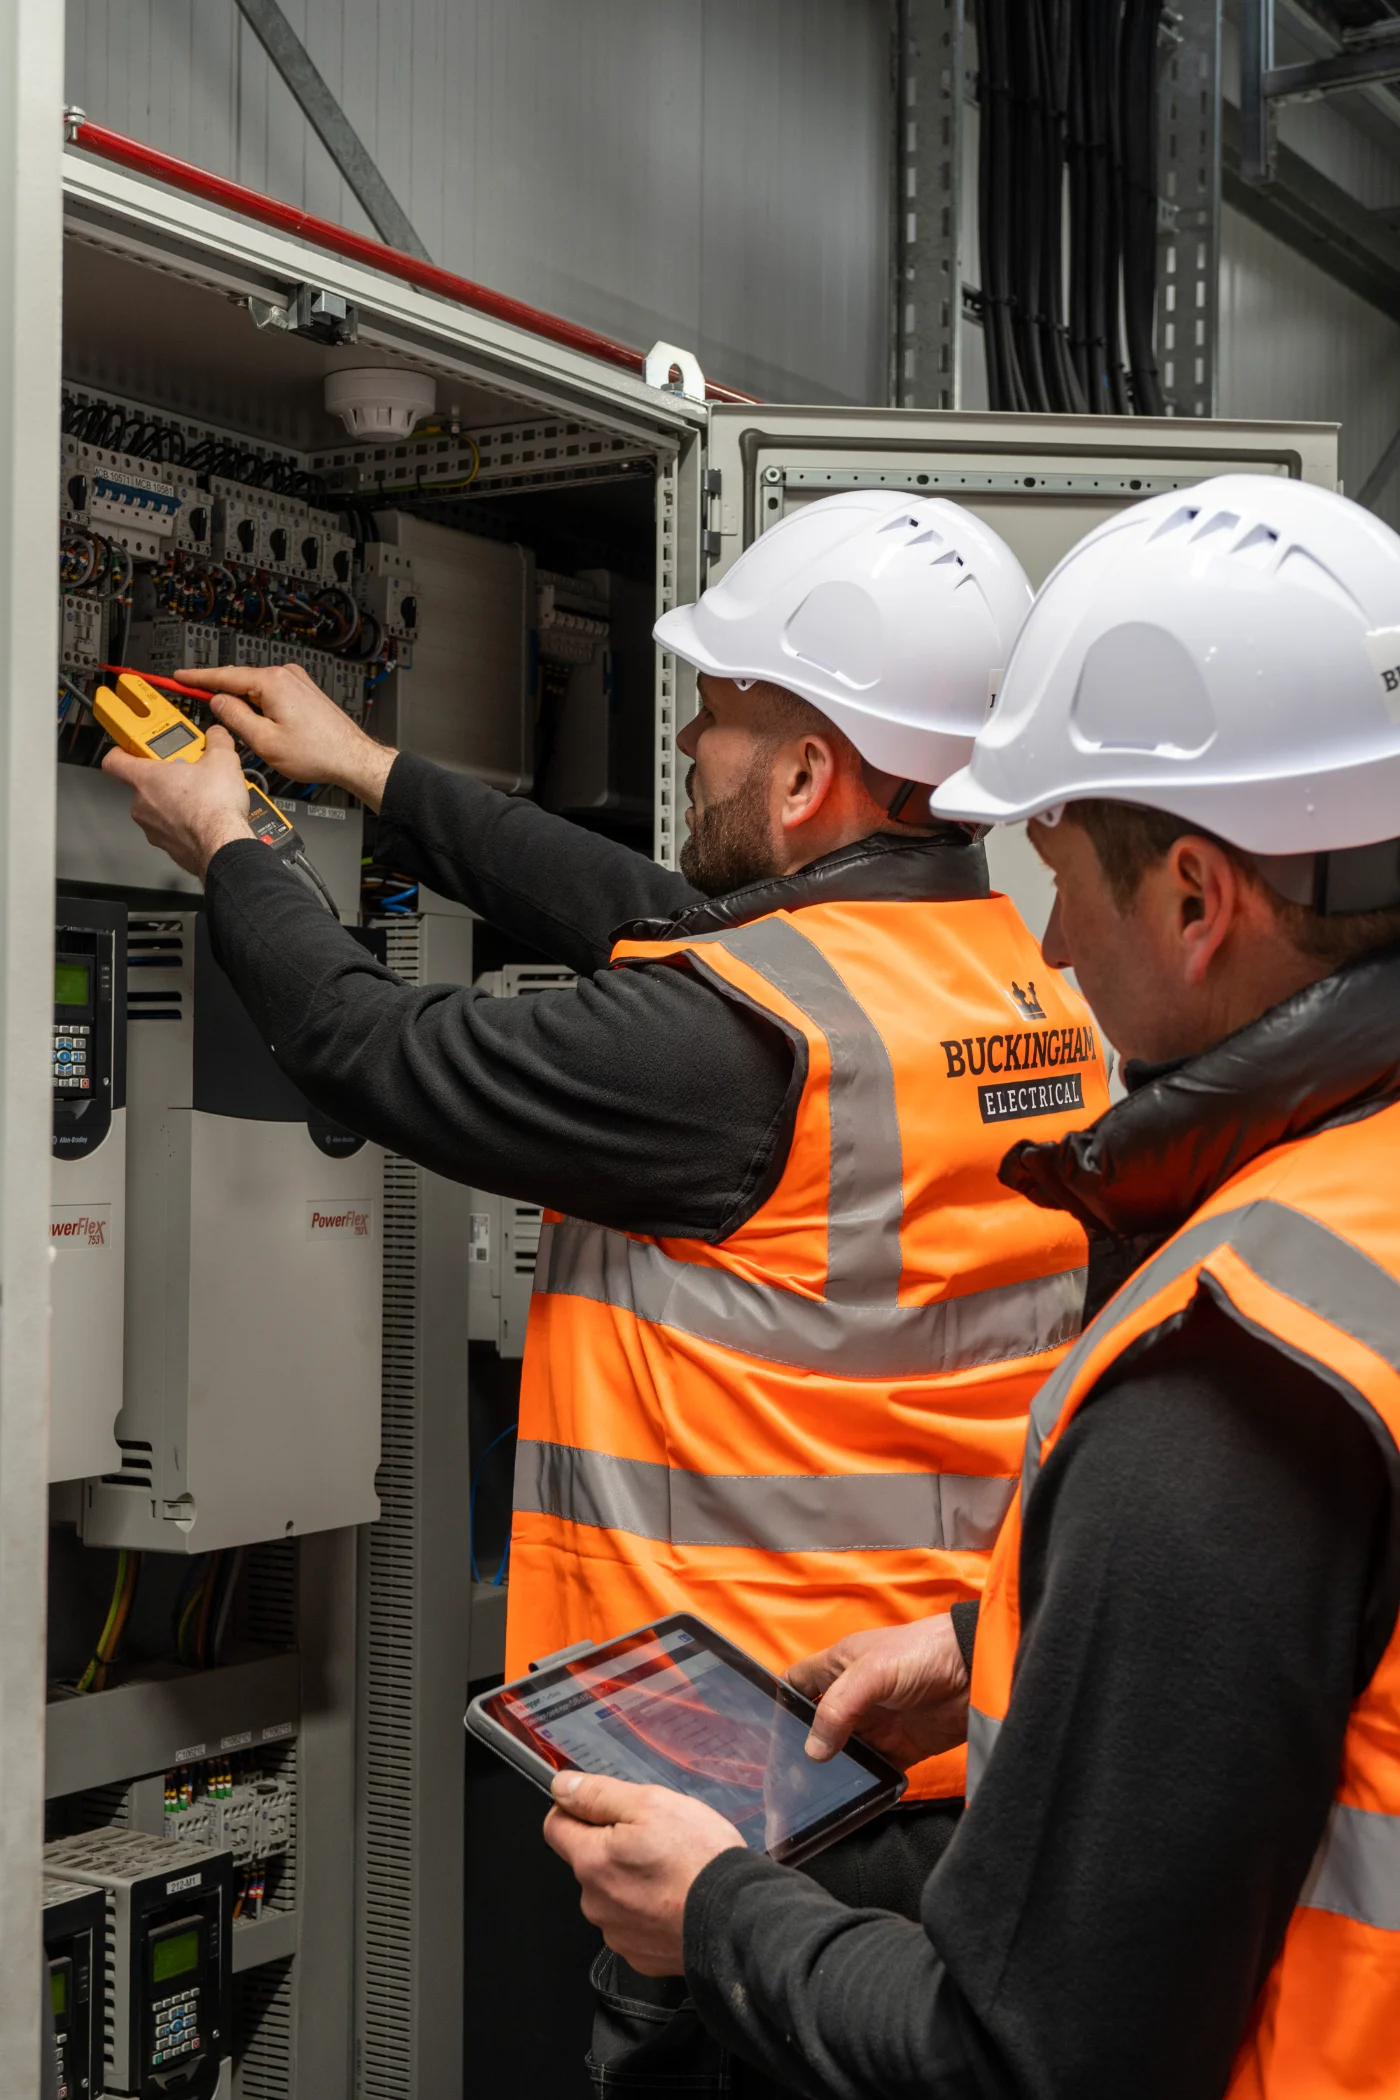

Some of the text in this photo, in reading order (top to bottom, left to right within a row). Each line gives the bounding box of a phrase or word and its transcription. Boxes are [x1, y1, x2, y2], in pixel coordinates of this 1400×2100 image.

[135, 477, 151, 490] MCB
[940, 1026, 1097, 1078] BUCKINGHAM
[984, 1081, 1080, 1116] ELECTRICAL
[50, 1216, 106, 1244] werFlex
[310, 1210, 369, 1236] PowerFlex
[88, 1235, 100, 1245] 753
[171, 1876, 196, 1892] 212-M1
